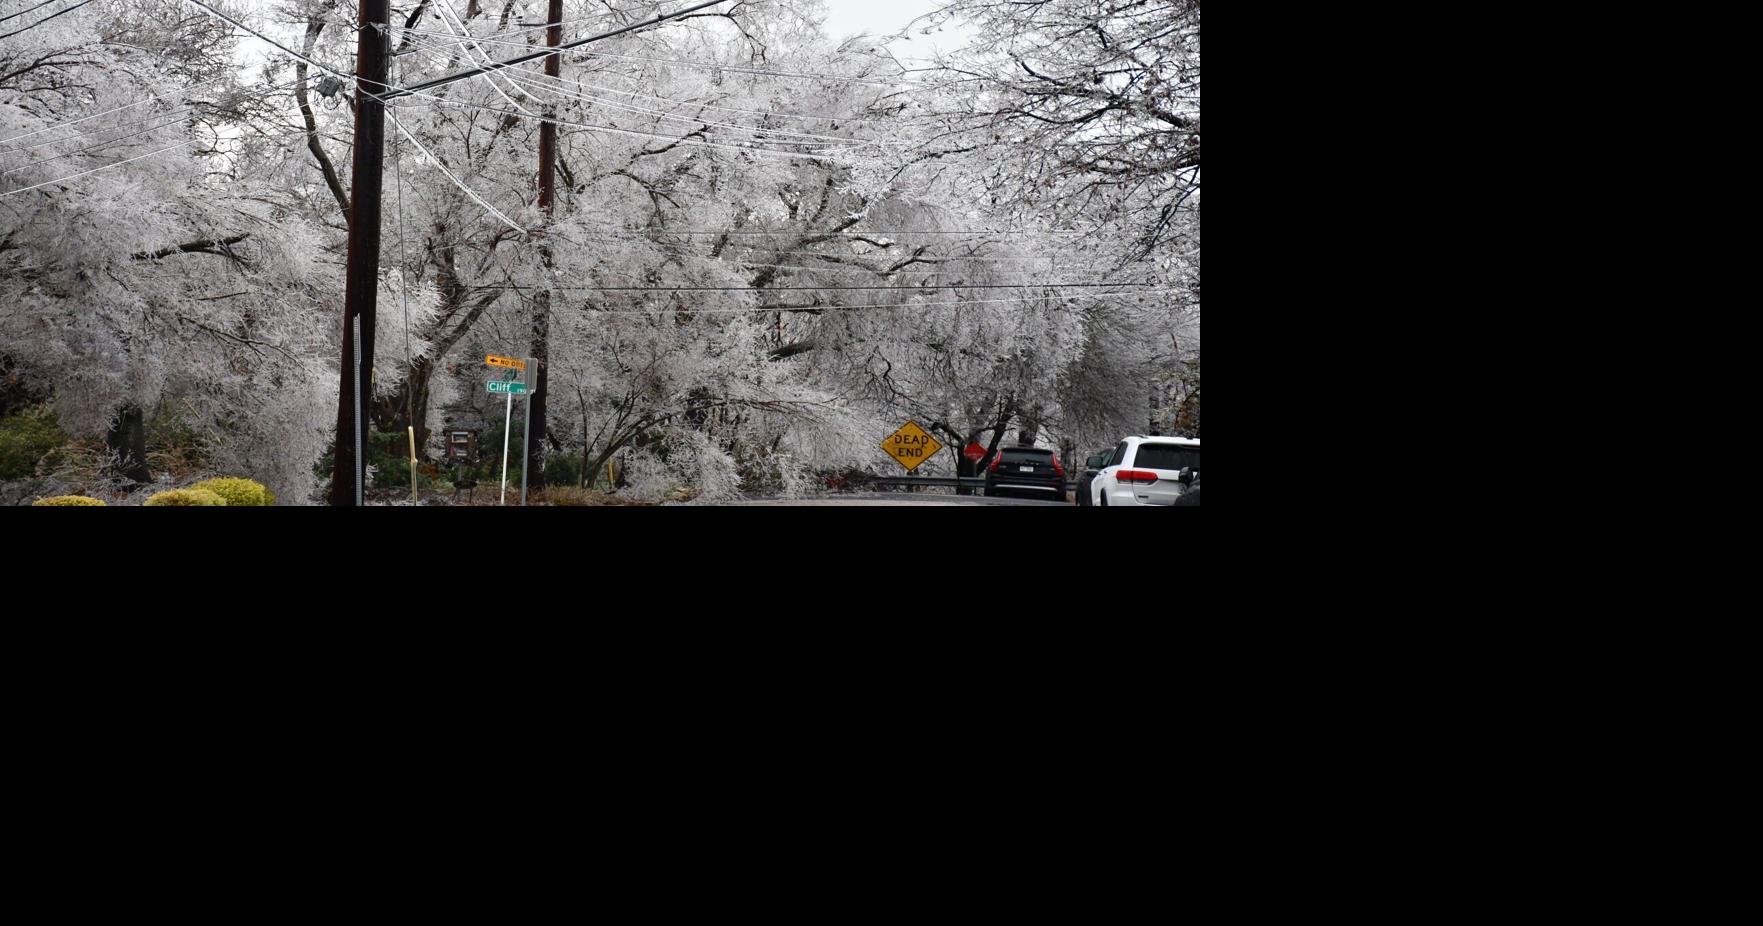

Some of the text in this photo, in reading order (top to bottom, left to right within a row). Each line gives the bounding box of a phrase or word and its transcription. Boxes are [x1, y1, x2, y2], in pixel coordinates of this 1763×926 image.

[489, 382, 511, 392] Cliff
[894, 434, 929, 446] DEAD
[898, 447, 923, 457] END
